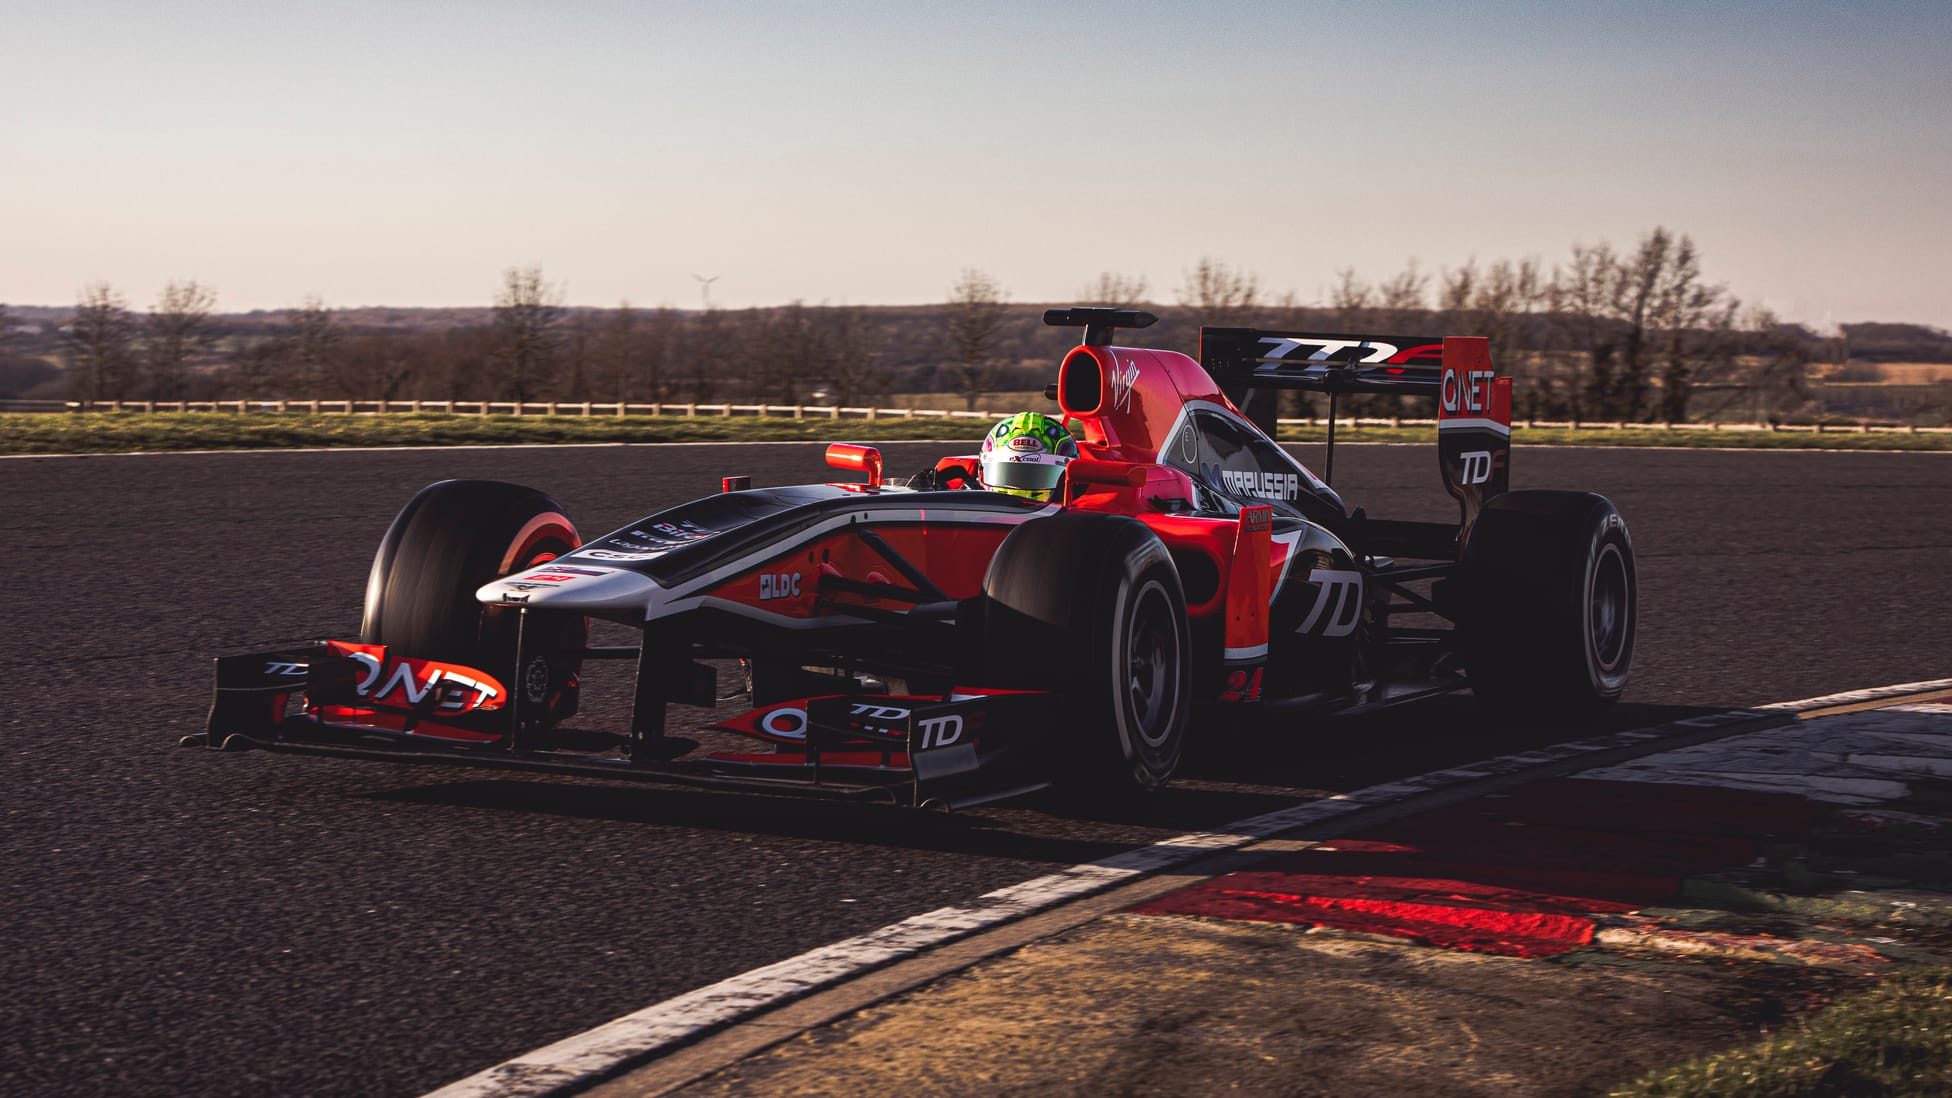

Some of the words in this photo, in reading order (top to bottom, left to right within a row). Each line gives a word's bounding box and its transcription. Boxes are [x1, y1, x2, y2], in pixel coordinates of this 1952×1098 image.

[1442, 368, 1495, 413] QNET
[1013, 439, 1038, 447] BELL
[1221, 470, 1299, 500] MARUSSIA
[771, 573, 800, 598] LDC
